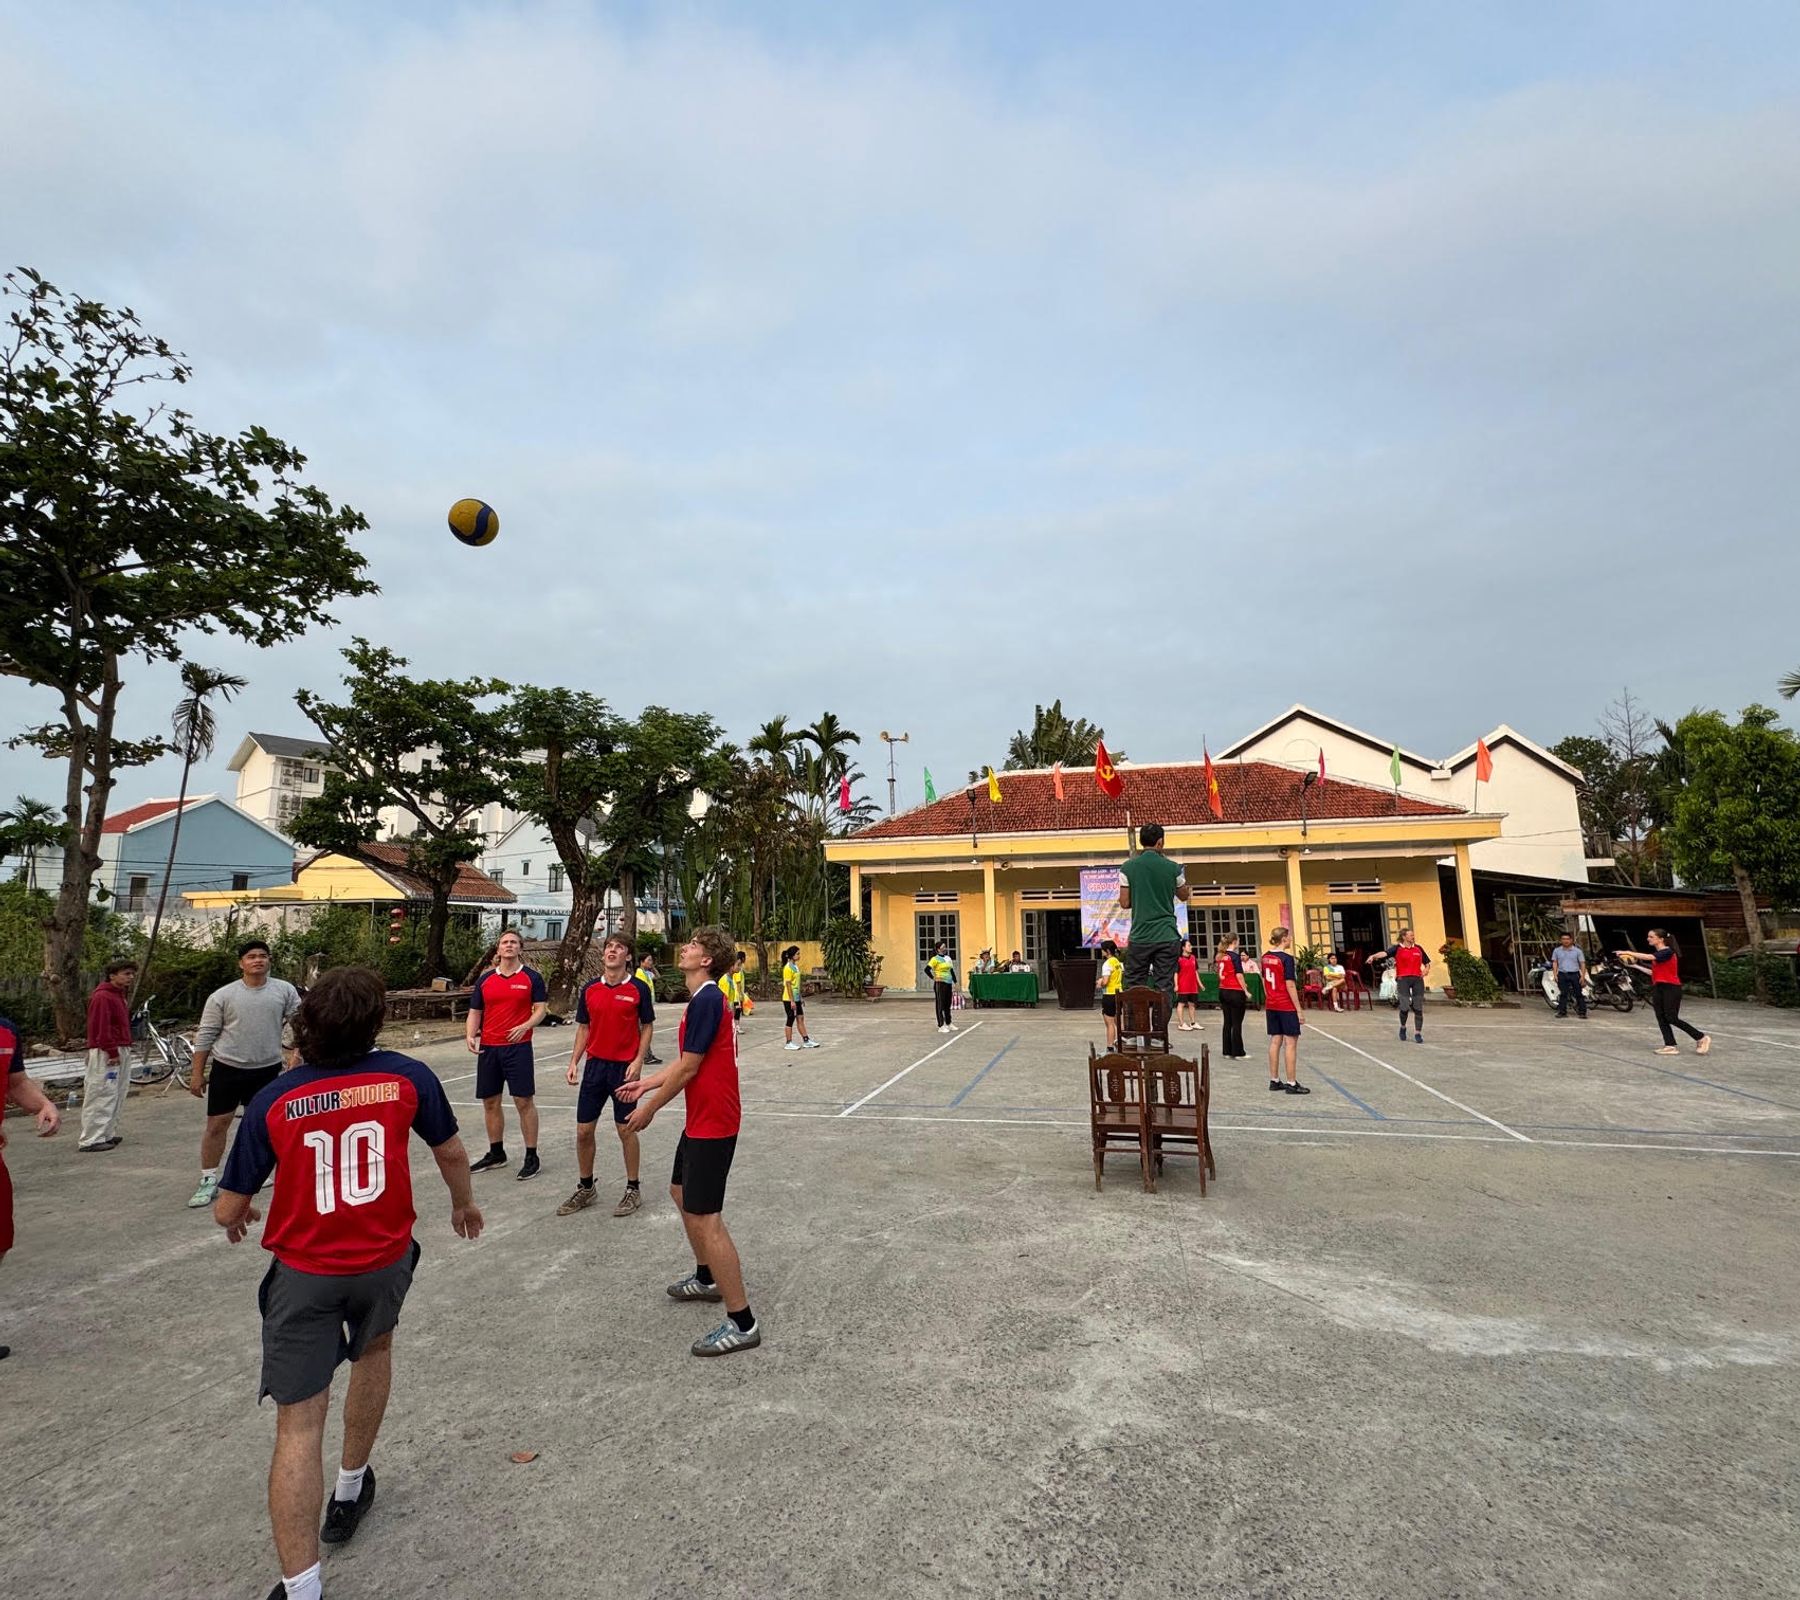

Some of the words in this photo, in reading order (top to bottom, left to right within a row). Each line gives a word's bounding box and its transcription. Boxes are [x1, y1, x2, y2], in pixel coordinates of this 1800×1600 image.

[1265, 967, 1276, 991] 4
[285, 1081, 400, 1121] KULTURSTUDIER
[304, 1120, 386, 1215] 10
